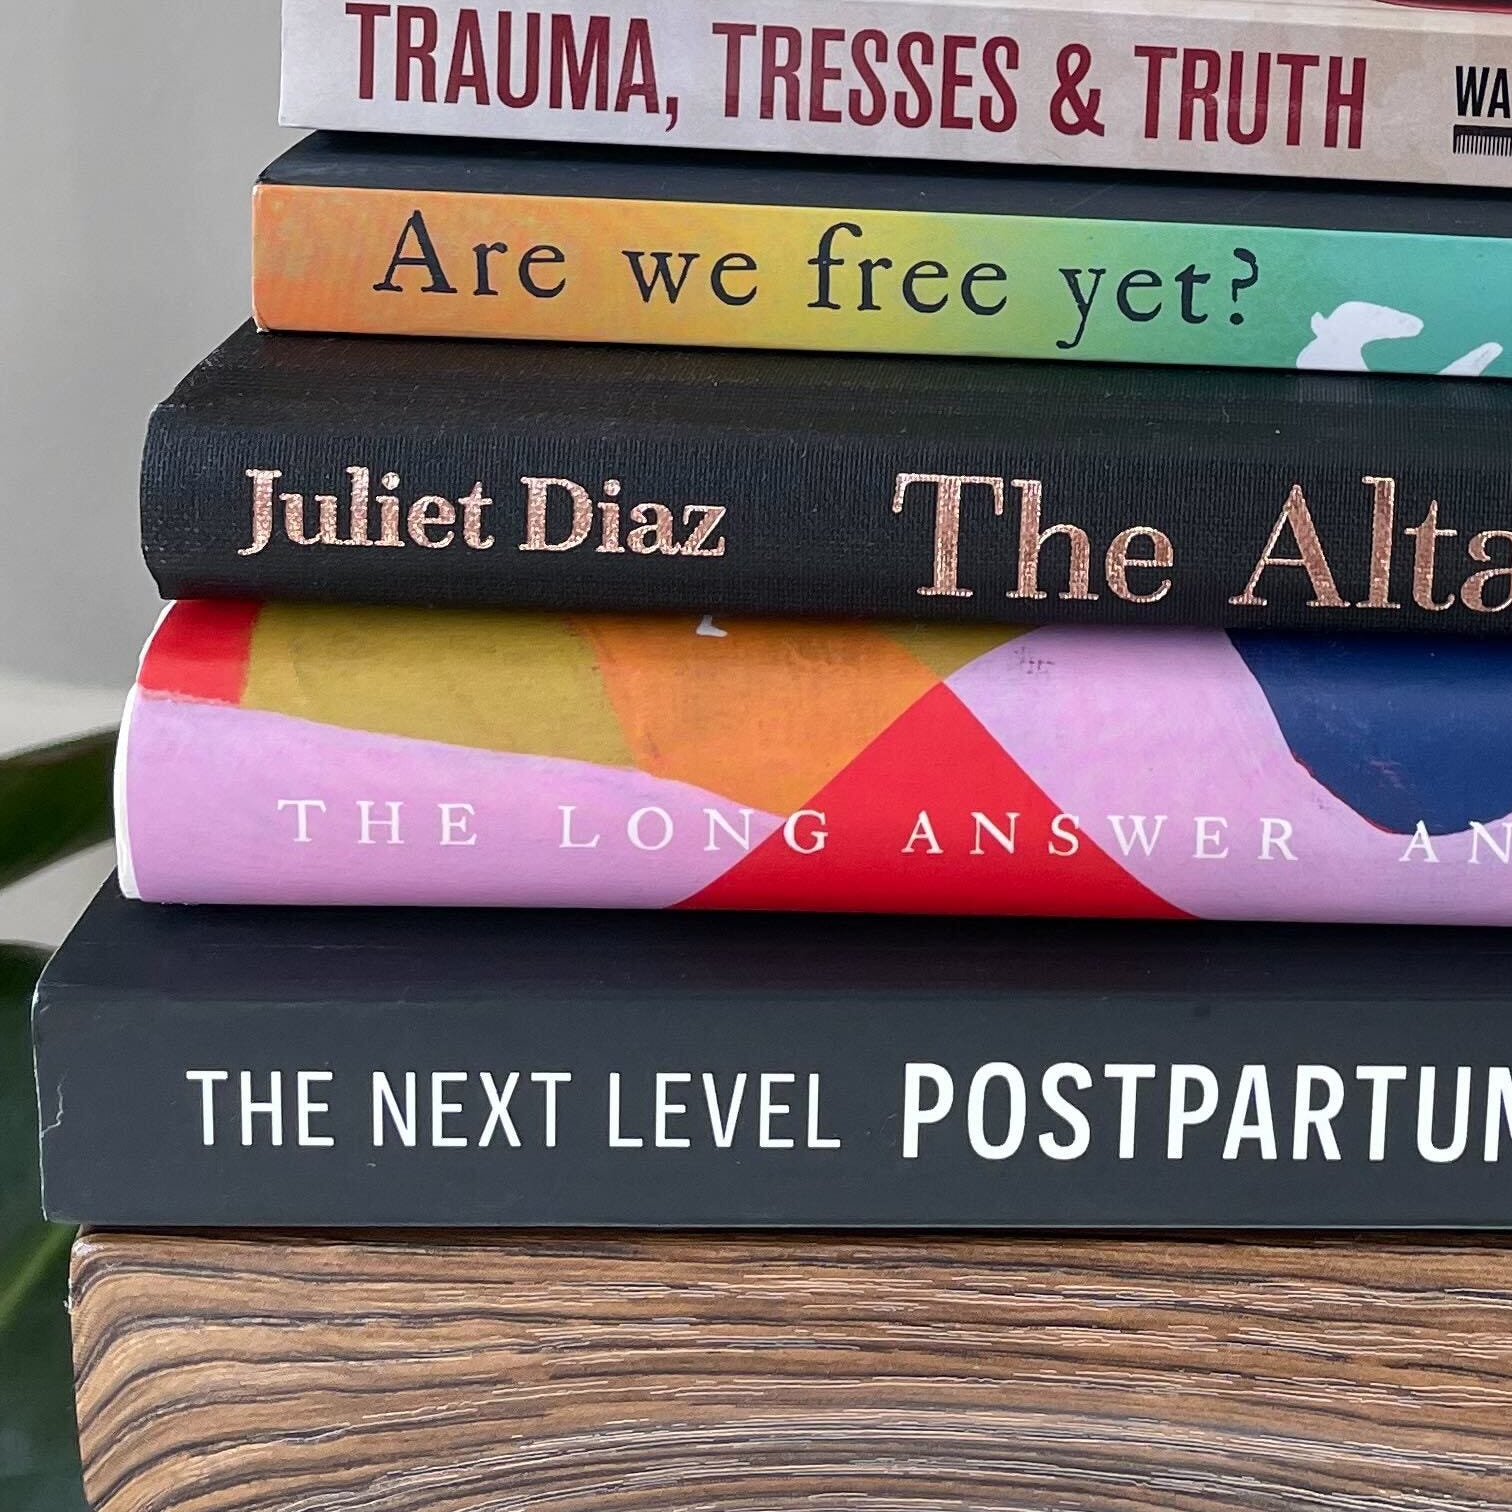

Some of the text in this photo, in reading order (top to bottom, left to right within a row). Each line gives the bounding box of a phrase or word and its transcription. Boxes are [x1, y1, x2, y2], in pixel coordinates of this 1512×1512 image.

[346, 3, 1366, 149] TRAUMA, TRESSES & TRUTH
[373, 210, 1258, 349] Are we free yet?
[238, 466, 726, 556] Juliet Diaz
[892, 473, 1173, 603] The
[277, 800, 1298, 860] THE LONG ANSWER
[186, 1071, 840, 1147] THE NEXT LEVEL
